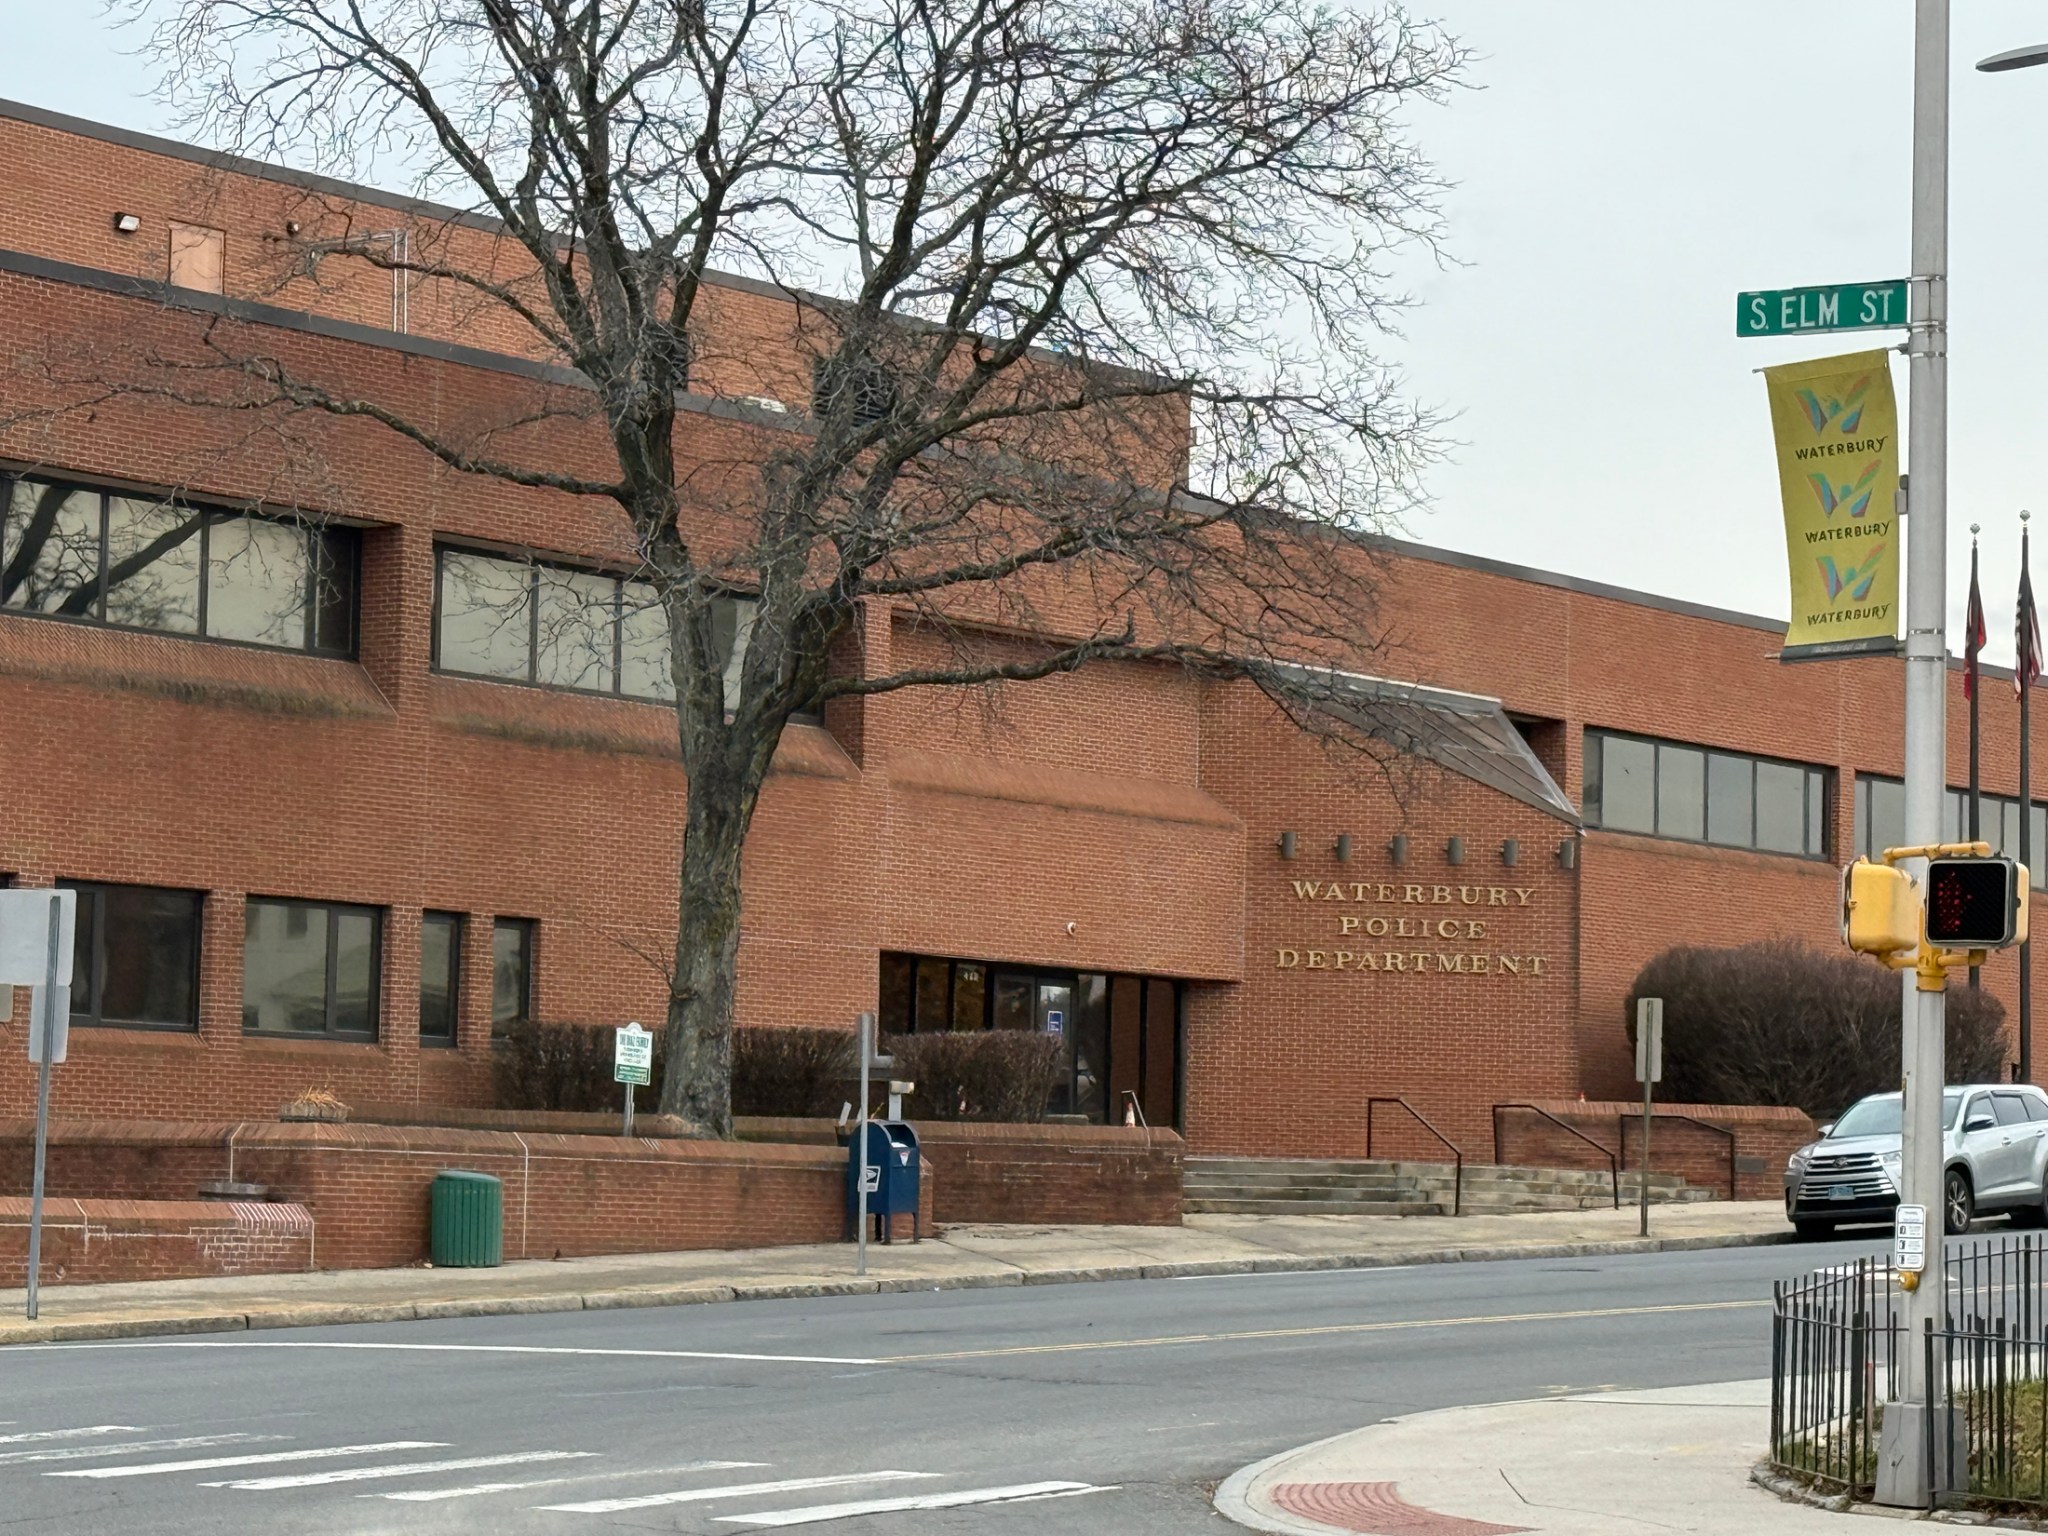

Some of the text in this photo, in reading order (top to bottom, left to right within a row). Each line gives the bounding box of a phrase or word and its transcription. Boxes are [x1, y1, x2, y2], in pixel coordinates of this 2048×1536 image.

[1781, 292, 1839, 329] ELM
[1860, 289, 1894, 323] ST
[1795, 436, 1888, 460] WATERBURY
[1805, 520, 1892, 544] WATERBURY
[1807, 603, 1892, 626] WATERBURY
[1291, 881, 1536, 906] WATERBURY
[1338, 916, 1487, 939] POLICE
[1275, 949, 1549, 976] DEPARTMENT
